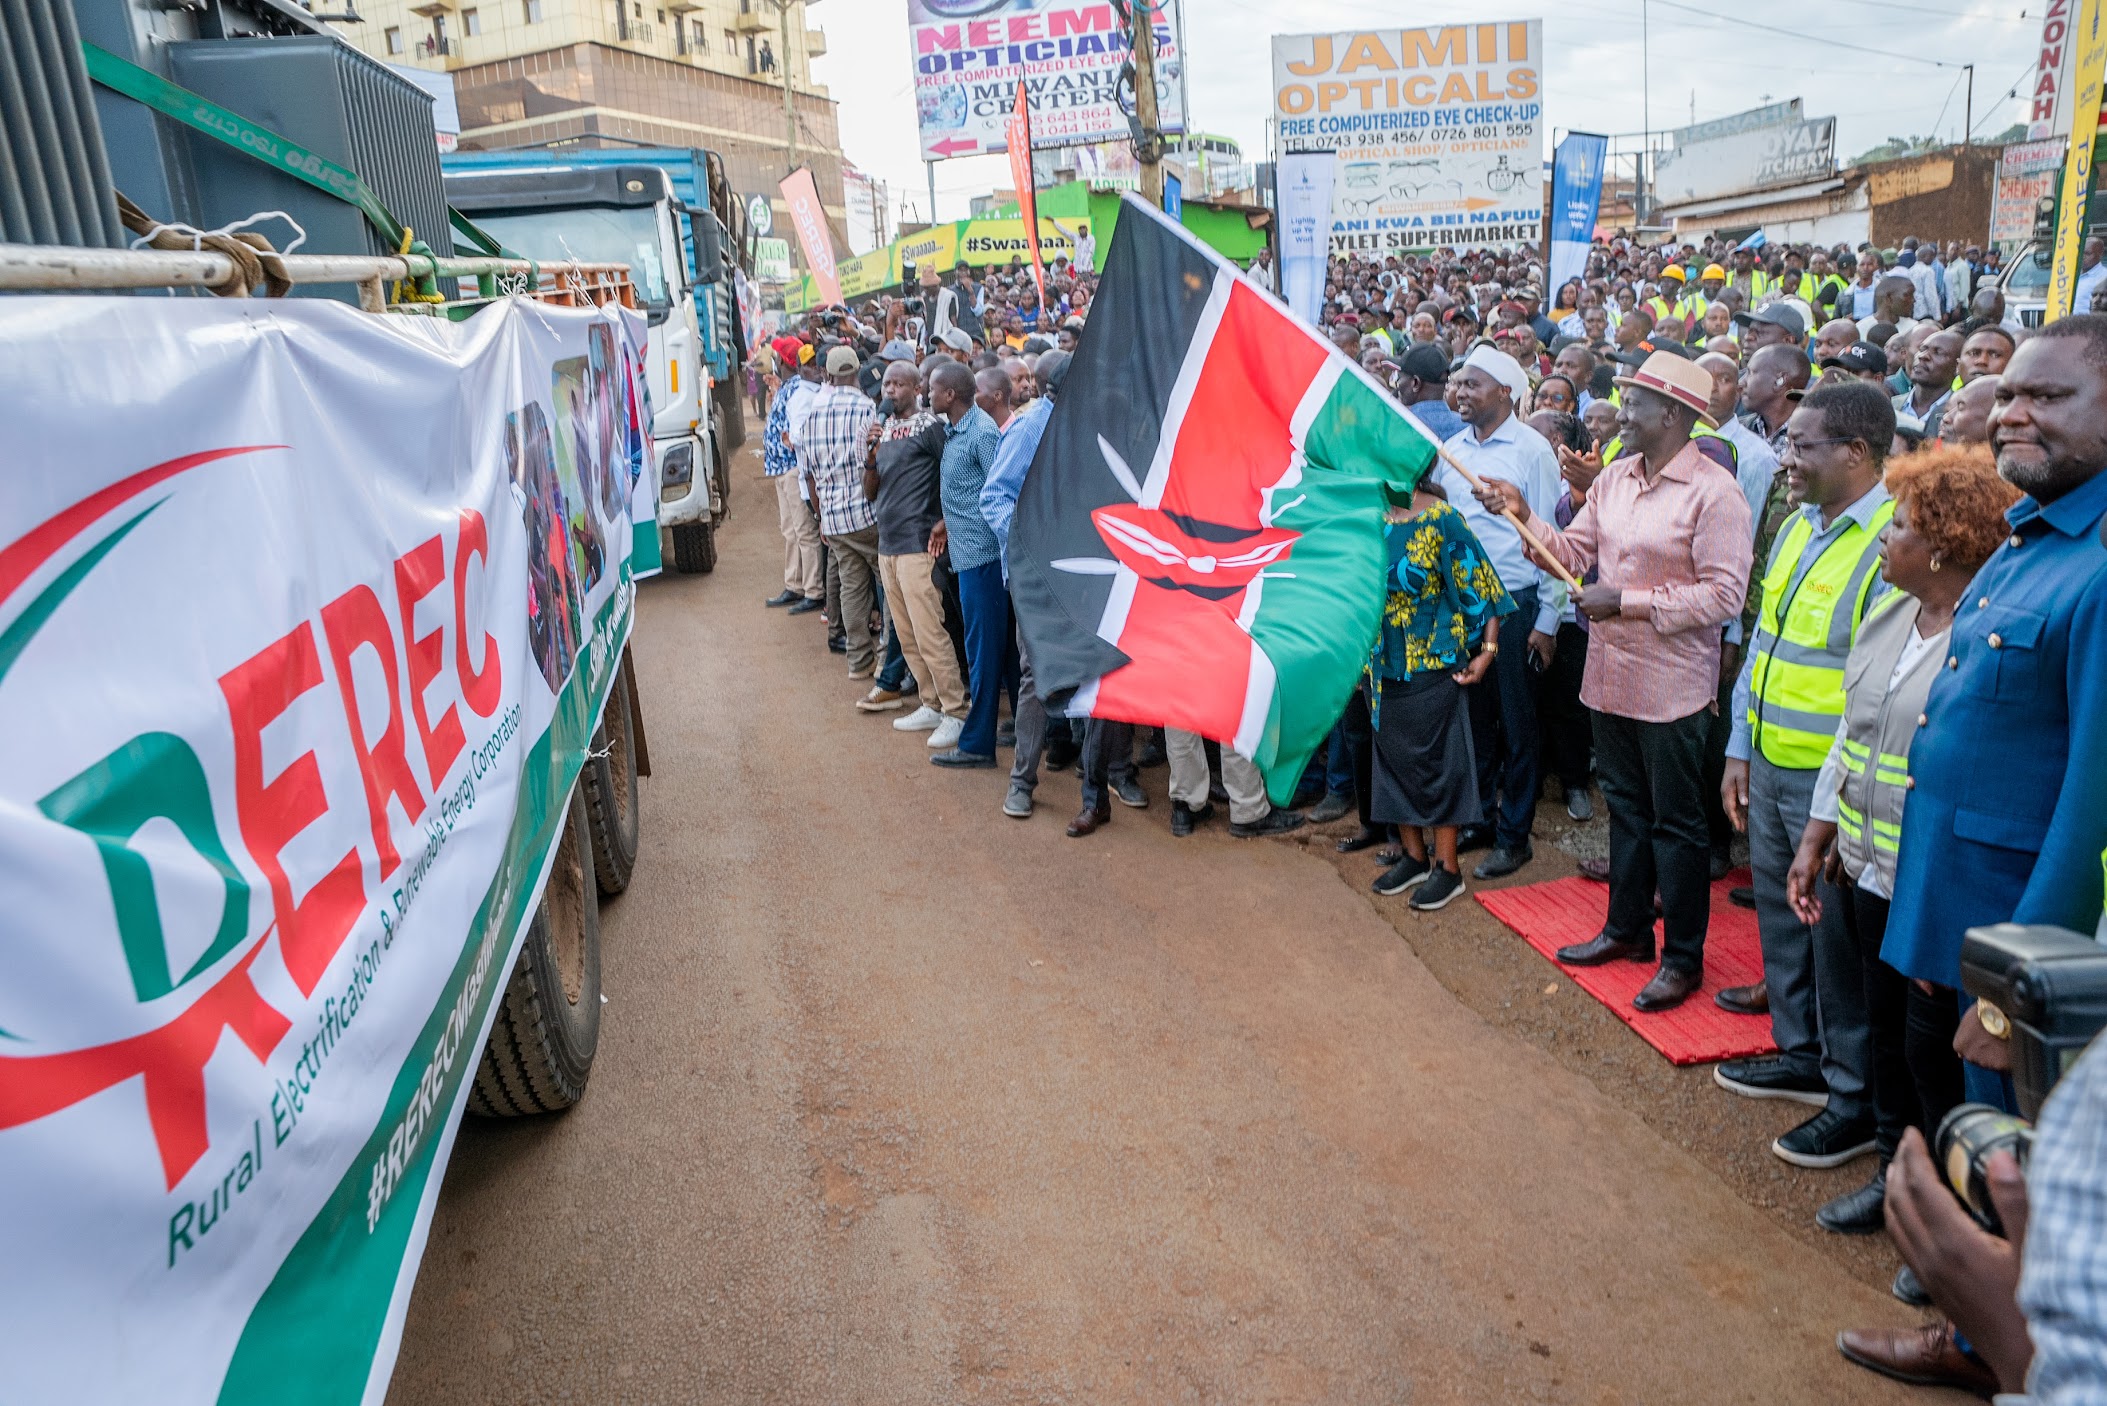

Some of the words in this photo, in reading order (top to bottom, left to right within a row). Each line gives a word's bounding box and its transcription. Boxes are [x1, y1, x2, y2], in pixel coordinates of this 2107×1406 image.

[918, 26, 1172, 75] OPTICIANS
[1286, 22, 1528, 76] JAMII
[916, 74, 950, 88] FREE
[955, 57, 1064, 83] COMPUTERIZED
[1069, 55, 1096, 69] EYE
[972, 69, 1117, 100] MIWANI
[973, 88, 1117, 117] CENTER
[1278, 68, 1538, 115] OPTICALS
[1047, 110, 1077, 124] 643
[1081, 106, 1111, 120] 864
[1048, 122, 1079, 135] 044
[1084, 119, 1112, 132] 156
[1280, 118, 1315, 136] FREE
[1319, 110, 1430, 134] COMPUTERIZED
[1434, 108, 1461, 127] EYE
[1464, 103, 1540, 124] CHECK-UP
[1038, 138, 1067, 149] MAKUTI
[1105, 132, 1128, 142] ROOM
[1338, 146, 1400, 159] OPTICAL
[1450, 138, 1529, 153] OPTICIANS
[1358, 133, 1384, 146] 938
[1391, 130, 1425, 143] 456/
[1431, 127, 1466, 141] 0726
[1473, 125, 1498, 138] 801
[1506, 123, 1533, 137] 555
[284, 150, 360, 199] Cargo
[1999, 180, 2048, 199] CHEMIST
[1333, 219, 1369, 233] ANI
[1375, 216, 1425, 231] KWA
[1430, 213, 1463, 226] BEI
[1469, 209, 1541, 224] NAFUU
[1386, 224, 1540, 248] SUPERMARKET
[168, 1119, 262, 1270] Rural
[271, 938, 380, 1149] Electrification
[380, 909, 394, 942] &
[441, 773, 476, 832] Energy
[471, 702, 523, 780] Corporation
